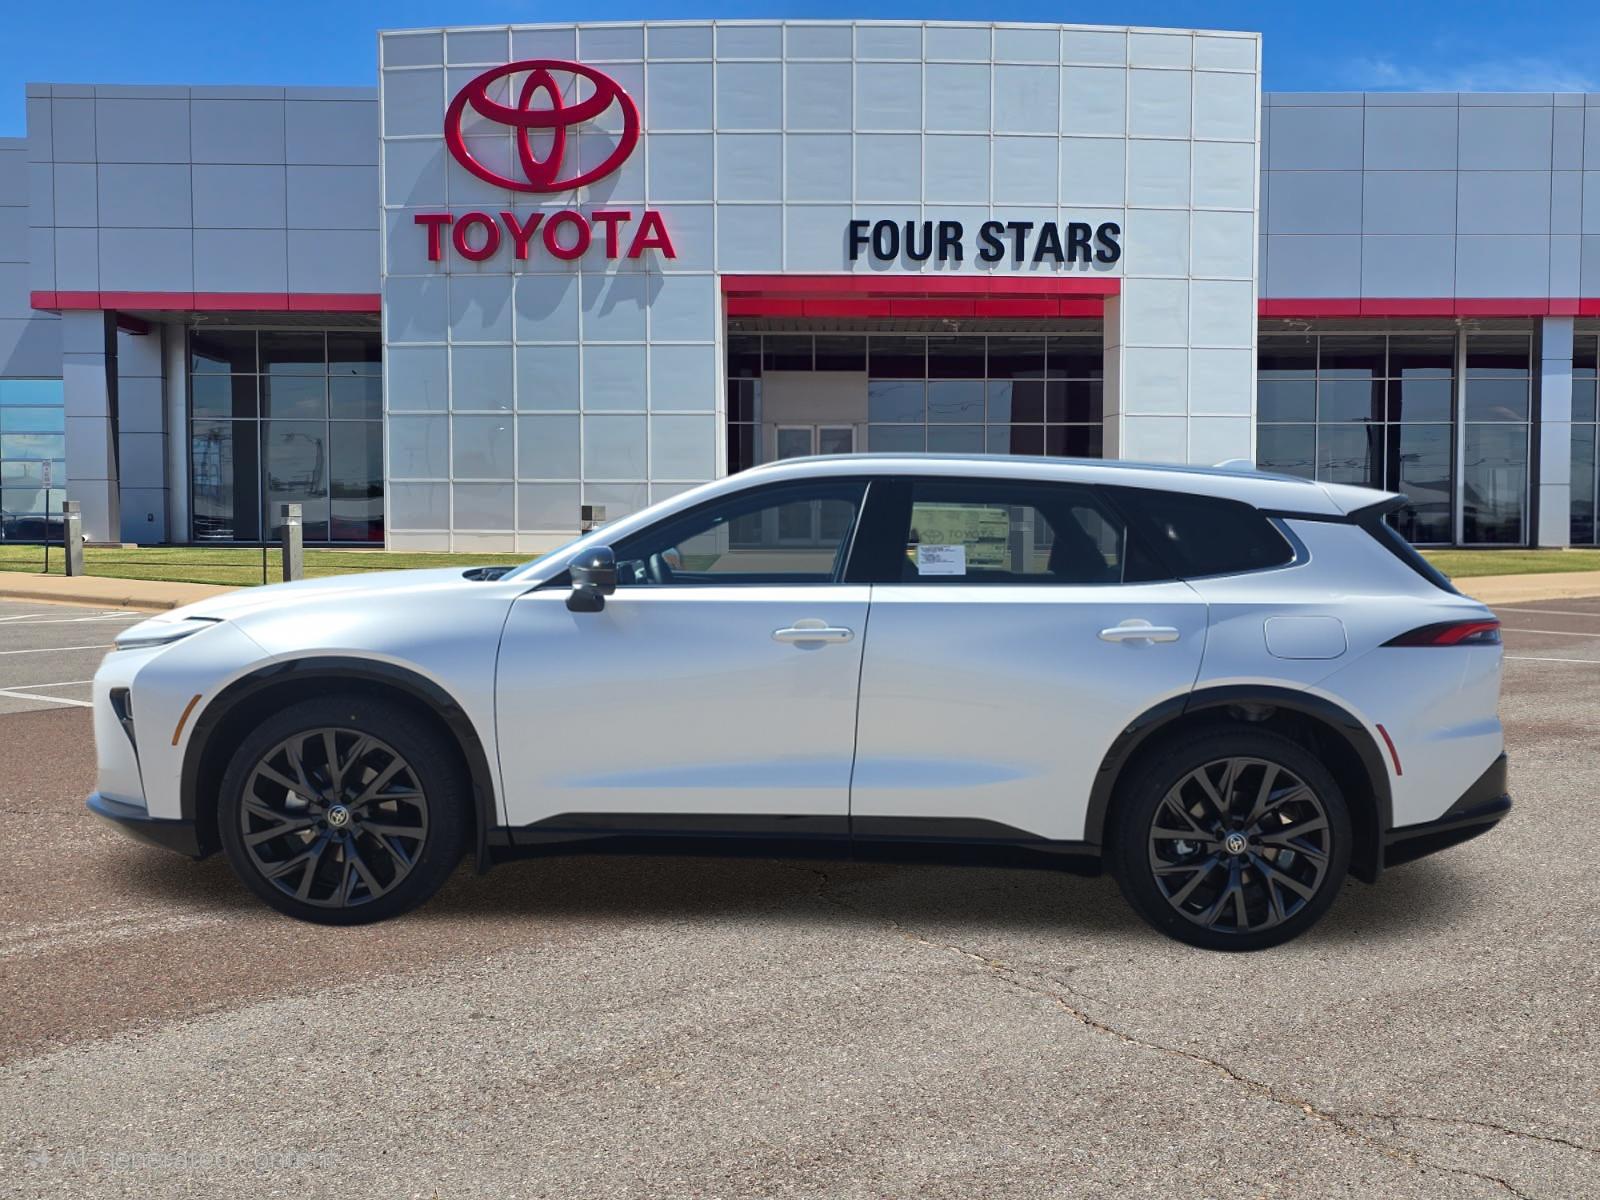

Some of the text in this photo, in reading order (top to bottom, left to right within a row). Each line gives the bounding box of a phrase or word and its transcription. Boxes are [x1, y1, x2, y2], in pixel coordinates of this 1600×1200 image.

[414, 210, 677, 261] TOYOTA
[849, 219, 1121, 263] FOUR STARS
[949, 529, 993, 539] TOYOTA
